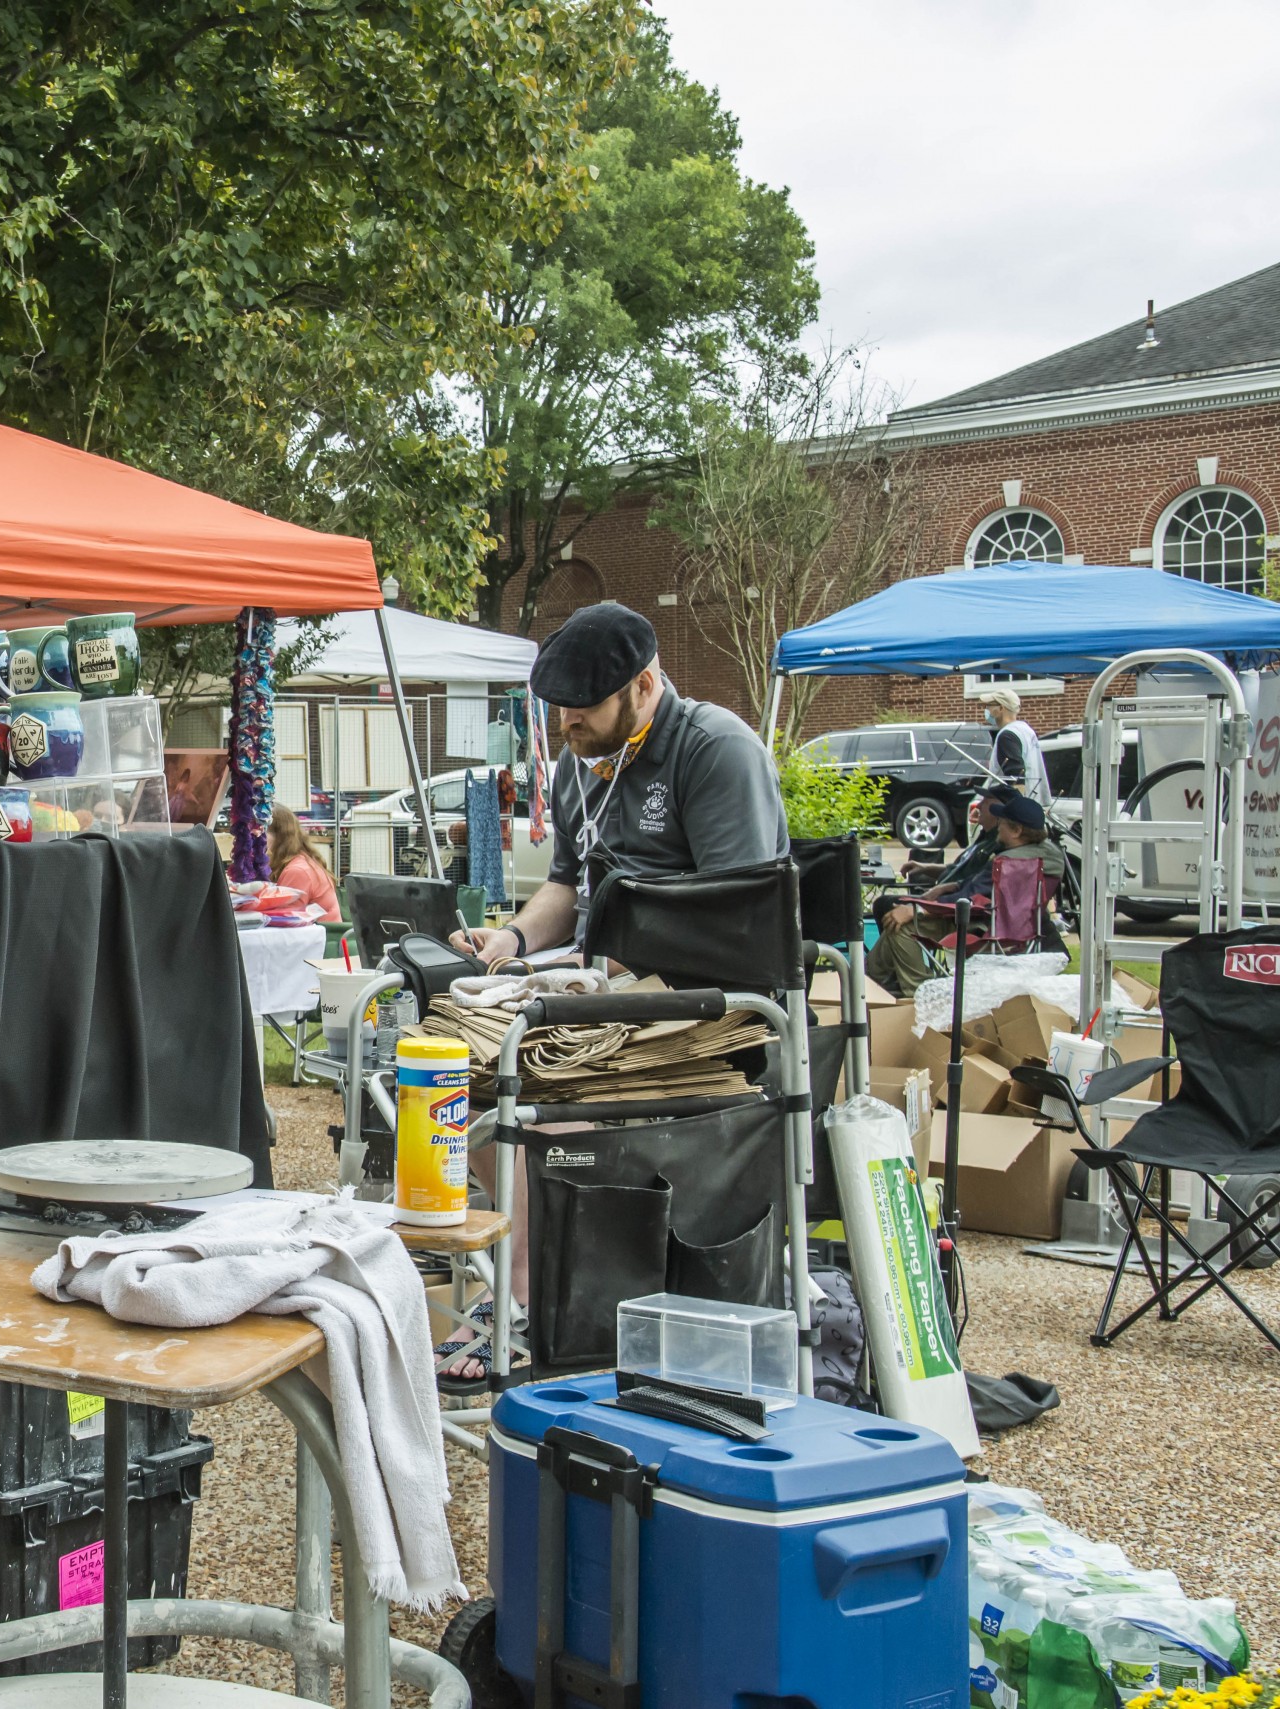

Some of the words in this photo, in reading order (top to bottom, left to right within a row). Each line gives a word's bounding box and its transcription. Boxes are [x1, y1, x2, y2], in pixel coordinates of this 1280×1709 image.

[78, 644, 111, 655] THOSE
[14, 656, 28, 664] Talk
[12, 666, 35, 675] Nerdy
[83, 664, 112, 672] WANDER
[97, 673, 113, 681] LOST
[18, 737, 28, 746] 20
[642, 805, 668, 819] STUDIOS
[639, 824, 664, 832] Ceramics
[640, 819, 665, 827] Handmade
[437, 1099, 468, 1126] CLOR
[449, 1145, 468, 1155] WIPE
[878, 1172, 887, 1195] 220
[883, 1198, 895, 1238] Sheets
[893, 1168, 922, 1275] Packing
[916, 1281, 940, 1362] Paper
[69, 1545, 104, 1568] EMPT
[68, 1558, 104, 1578] STORA
[983, 1616, 999, 1631] 32
